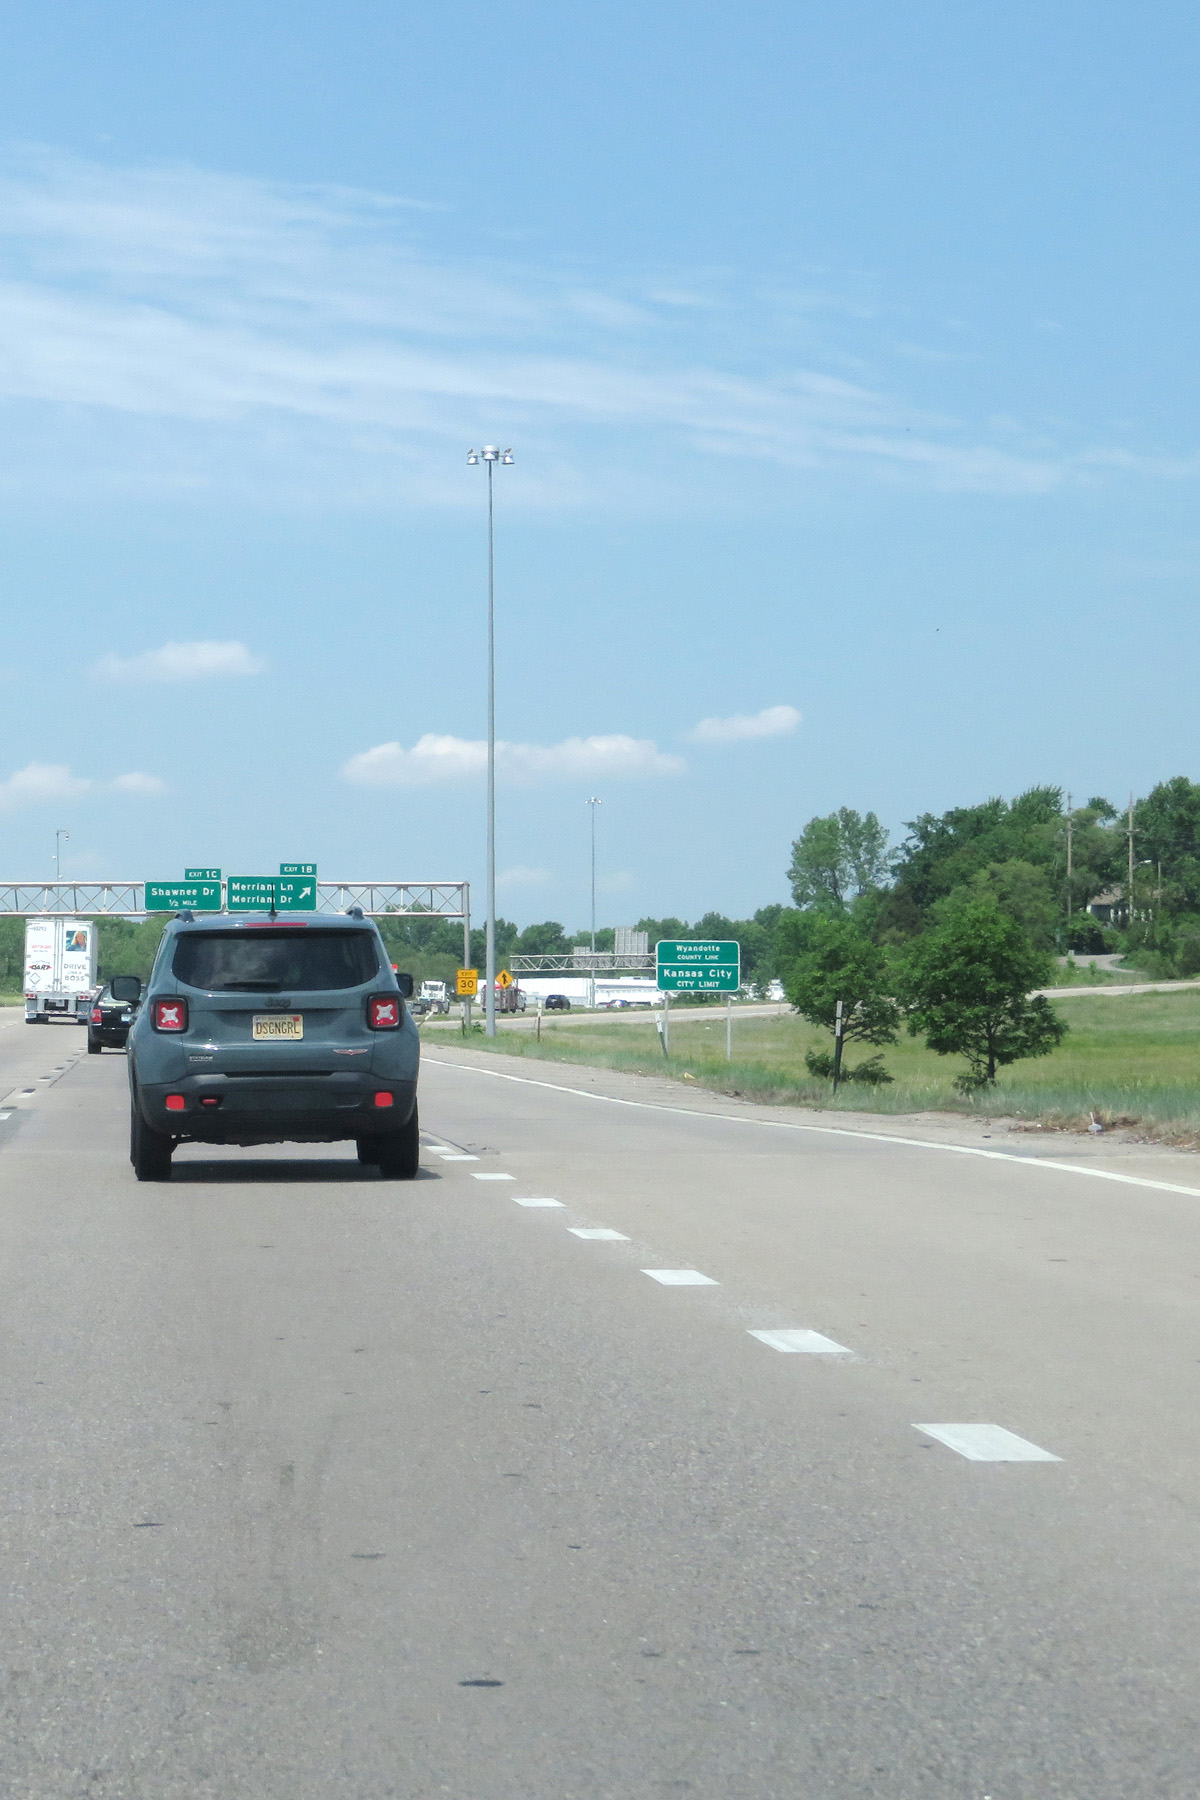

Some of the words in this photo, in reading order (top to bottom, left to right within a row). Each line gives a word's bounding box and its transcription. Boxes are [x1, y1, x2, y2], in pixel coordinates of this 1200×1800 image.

[301, 865, 313, 873] 1B
[205, 870, 217, 878] 1C
[232, 882, 276, 891] Merriam
[280, 883, 294, 891] Ln
[151, 887, 198, 896] Shawnee
[202, 887, 215, 896] Dr
[232, 895, 276, 904] Merriam
[280, 895, 293, 904] Dr
[676, 944, 720, 953] Wyandotte
[663, 968, 703, 978] Kansas
[708, 969, 732, 979] City
[460, 979, 474, 988] 30
[676, 980, 695, 988] CITY
[255, 1021, 300, 1035] DSGNGRL
